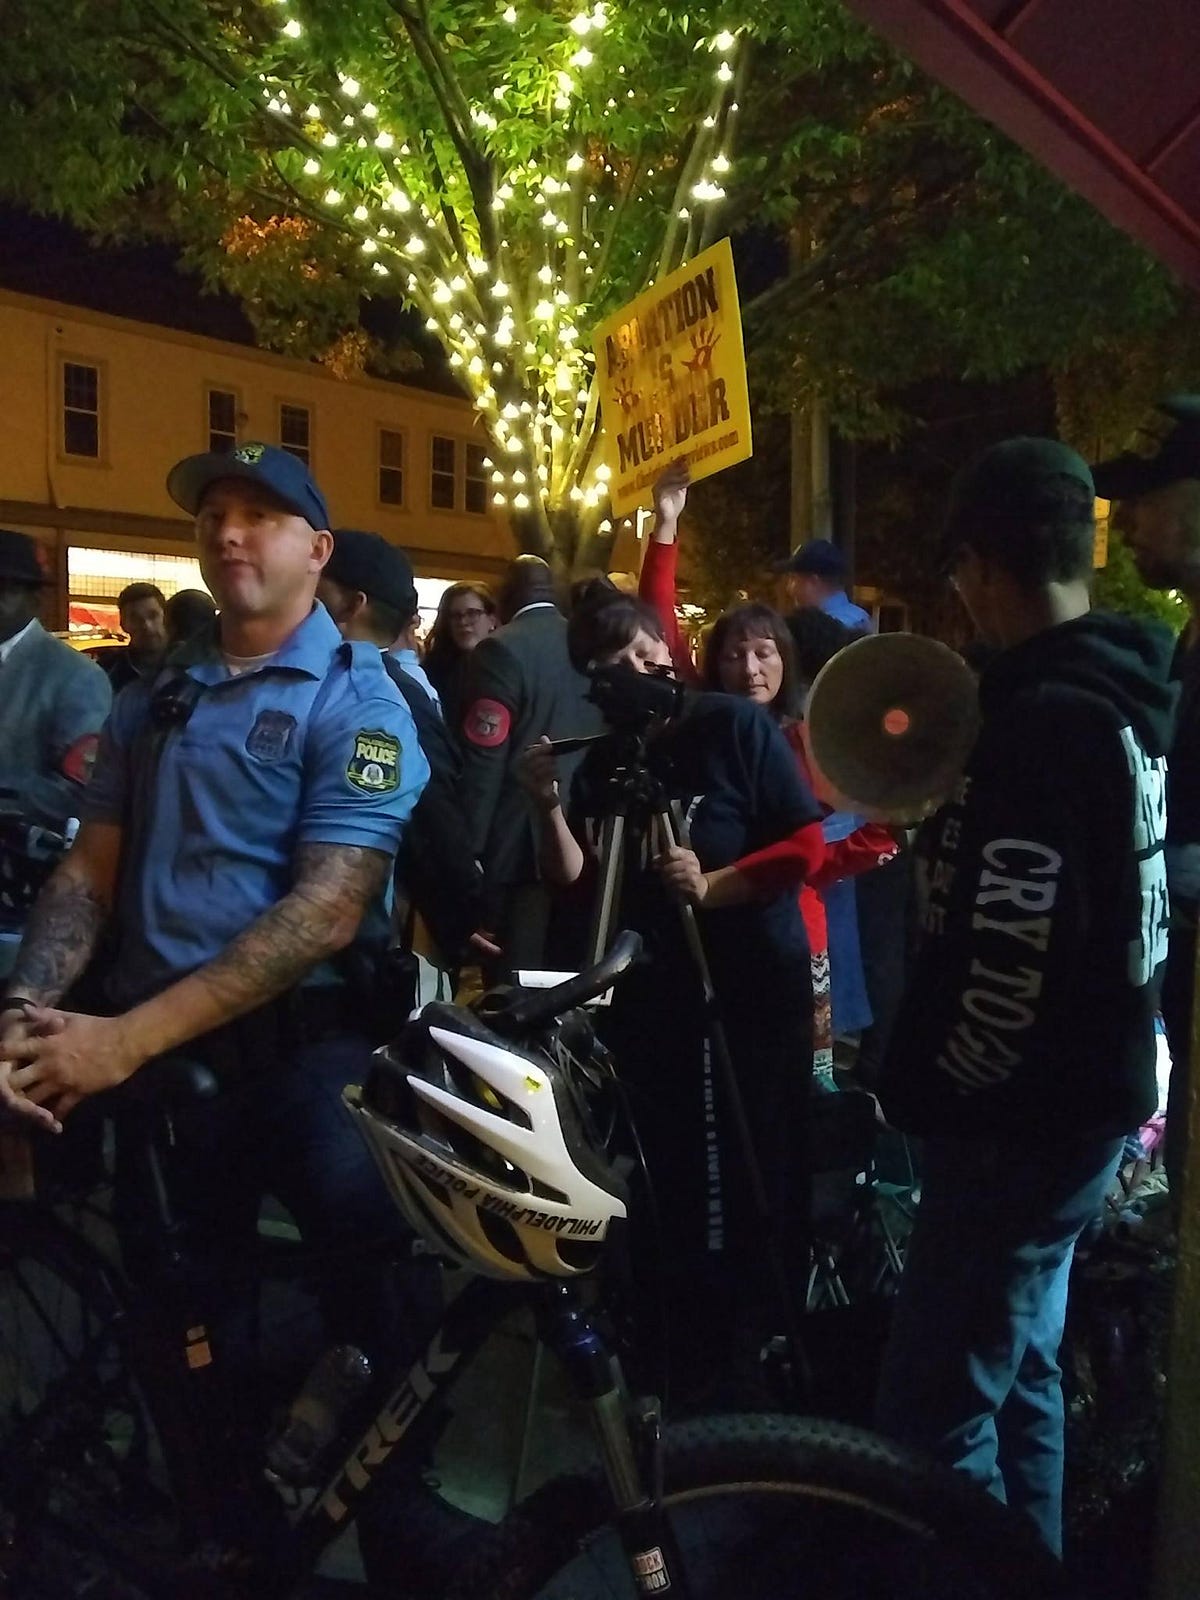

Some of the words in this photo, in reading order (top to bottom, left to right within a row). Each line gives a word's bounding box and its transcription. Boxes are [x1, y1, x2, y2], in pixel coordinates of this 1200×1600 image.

[605, 265, 720, 379] ARTION
[617, 377, 730, 474] MUDER
[356, 742, 397, 767] POLICE
[972, 838, 1063, 952] CRY
[416, 1155, 481, 1199] POLICE
[481, 1192, 603, 1236] PHILADELPHIA
[312, 1327, 462, 1523] TREK
